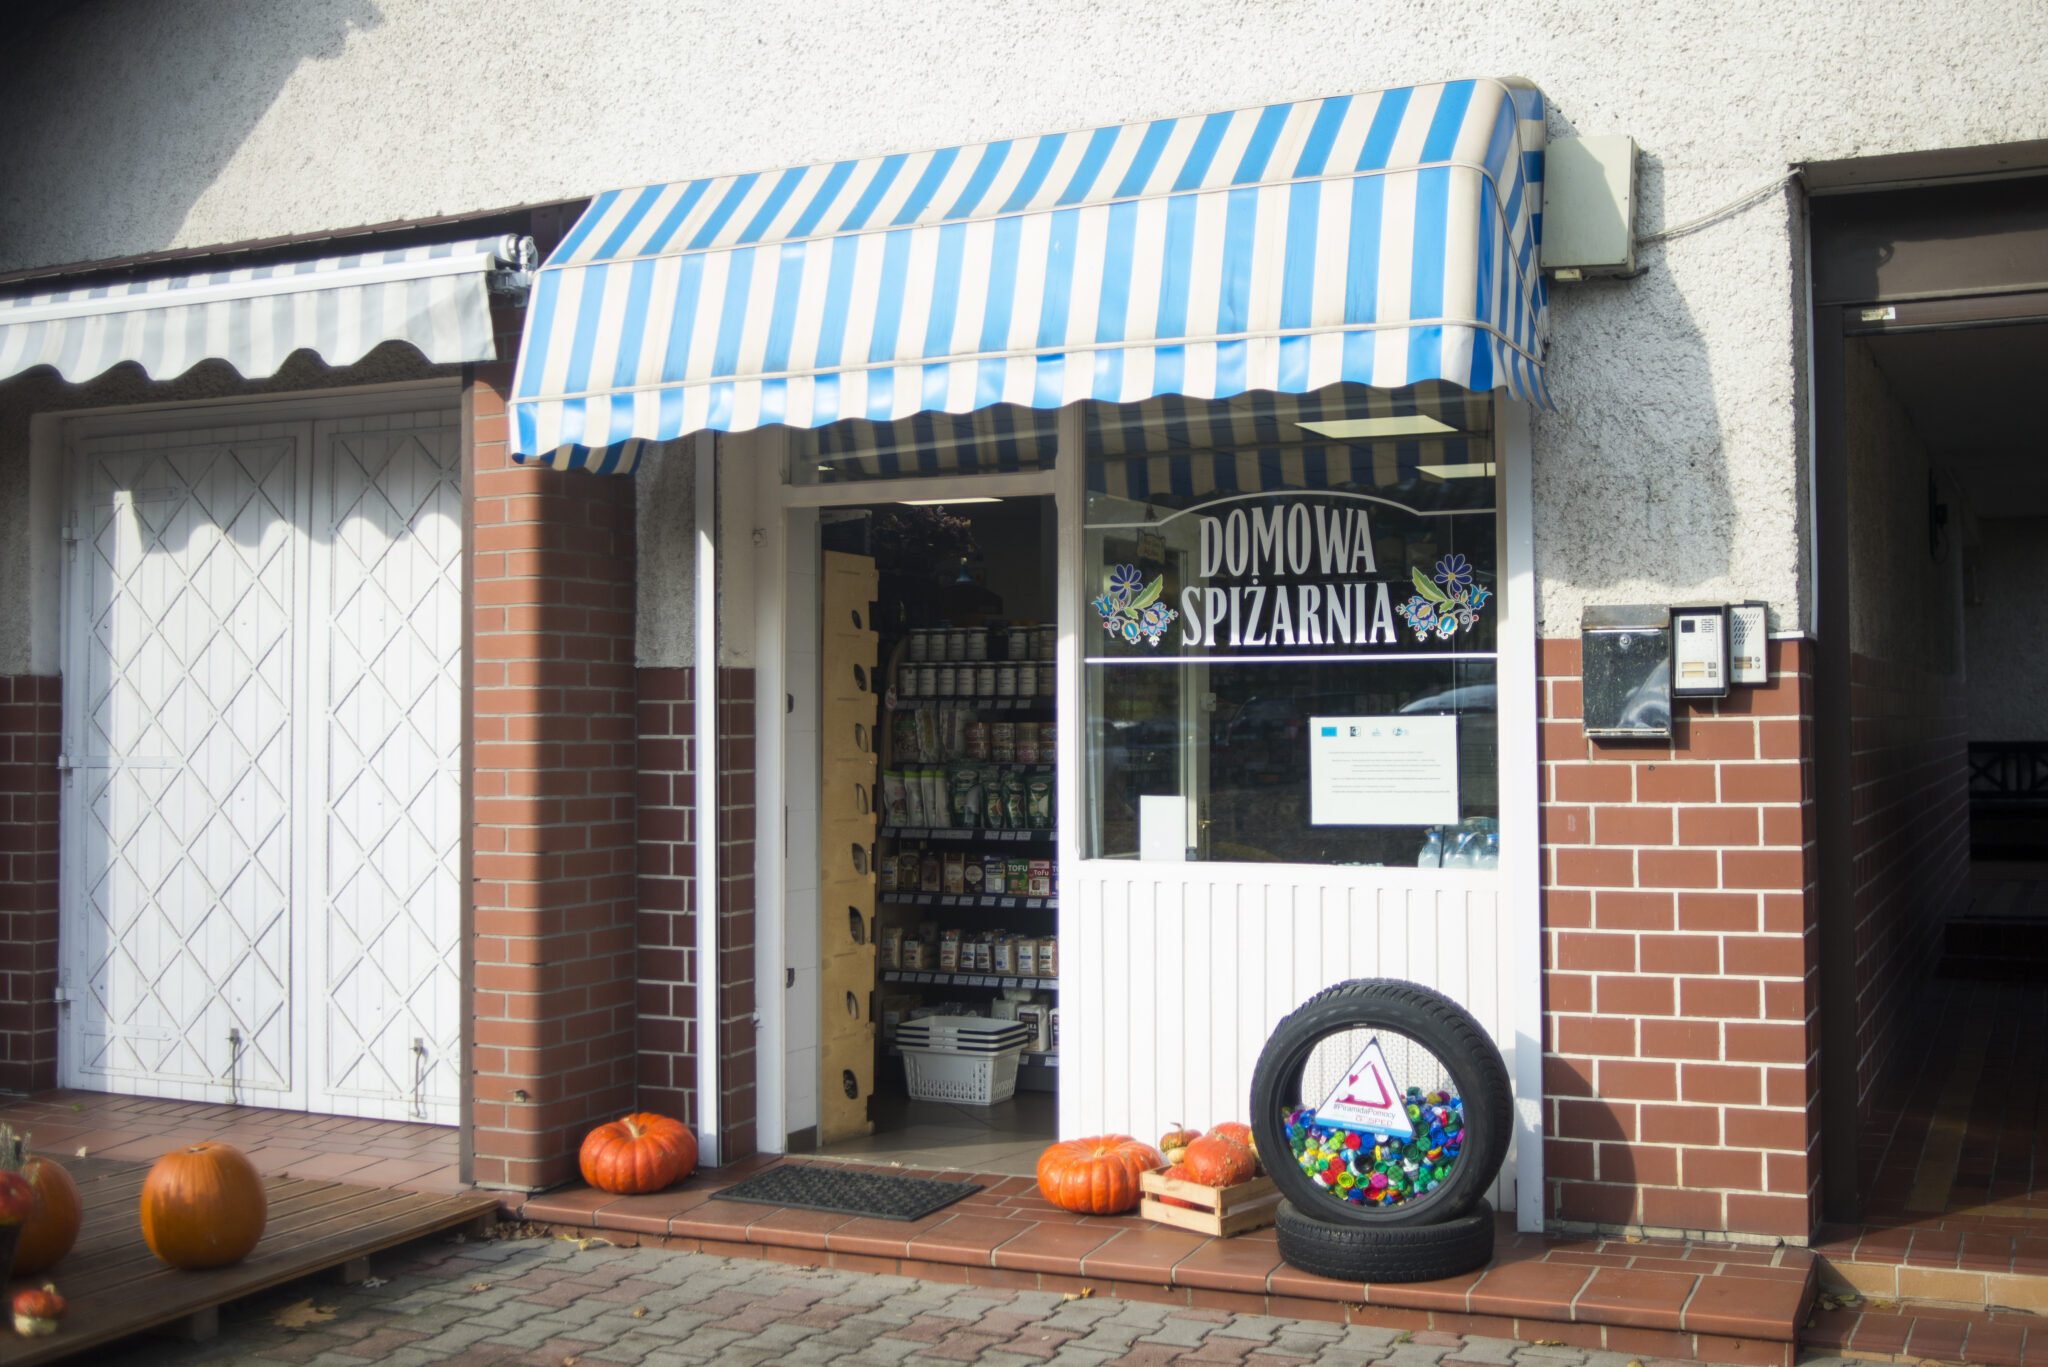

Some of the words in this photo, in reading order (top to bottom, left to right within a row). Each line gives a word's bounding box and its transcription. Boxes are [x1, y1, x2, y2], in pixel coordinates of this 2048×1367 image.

[1200, 502, 1377, 578] DOMOWA
[1181, 578, 1397, 646] SPIŻARNIA
[1008, 864, 1028, 872] TOFU
[1334, 1103, 1396, 1119] #PiramidaPomocy
